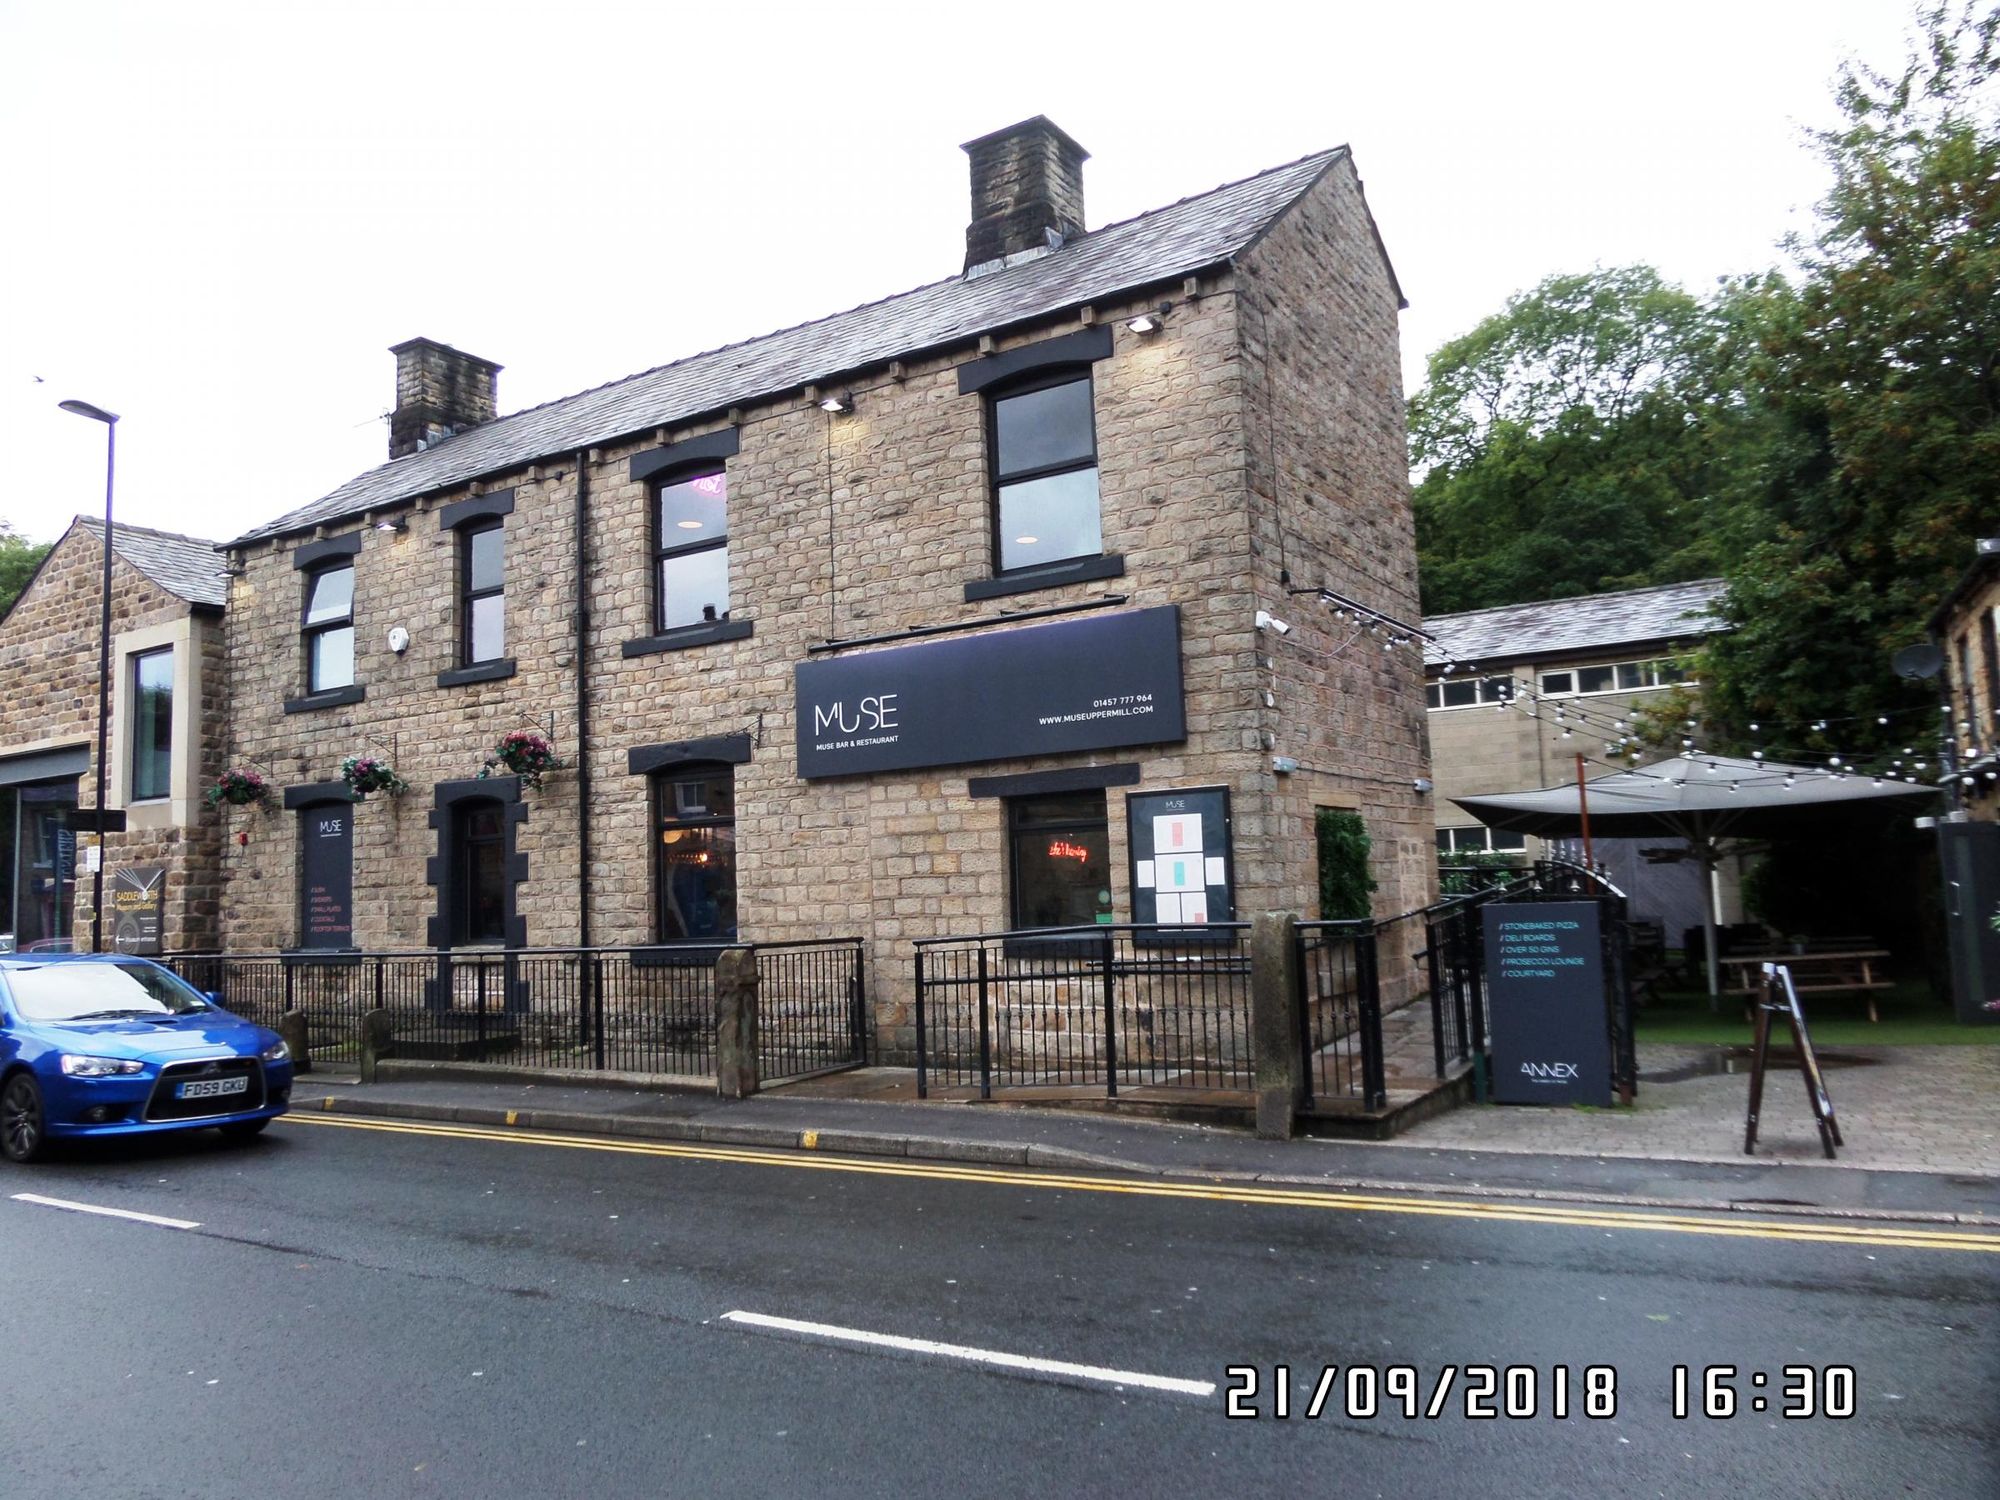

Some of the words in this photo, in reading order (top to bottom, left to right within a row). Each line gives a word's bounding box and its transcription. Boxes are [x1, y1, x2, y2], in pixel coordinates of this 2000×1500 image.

[1093, 698, 1117, 708] 01457
[1120, 695, 1134, 705] 777
[1136, 693, 1153, 702] 964
[815, 694, 899, 736] MUSE
[1039, 705, 1153, 725] WWW.MUSEUPPERMILL.COM
[816, 742, 835, 751] MUSE
[836, 741, 849, 749] BAR
[856, 735, 899, 746] RESTAURANT
[1165, 799, 1185, 809] MUSE
[320, 819, 342, 832] MUSE
[1521, 1062, 1579, 1078] ANNEX
[185, 1082, 219, 1096] FD59
